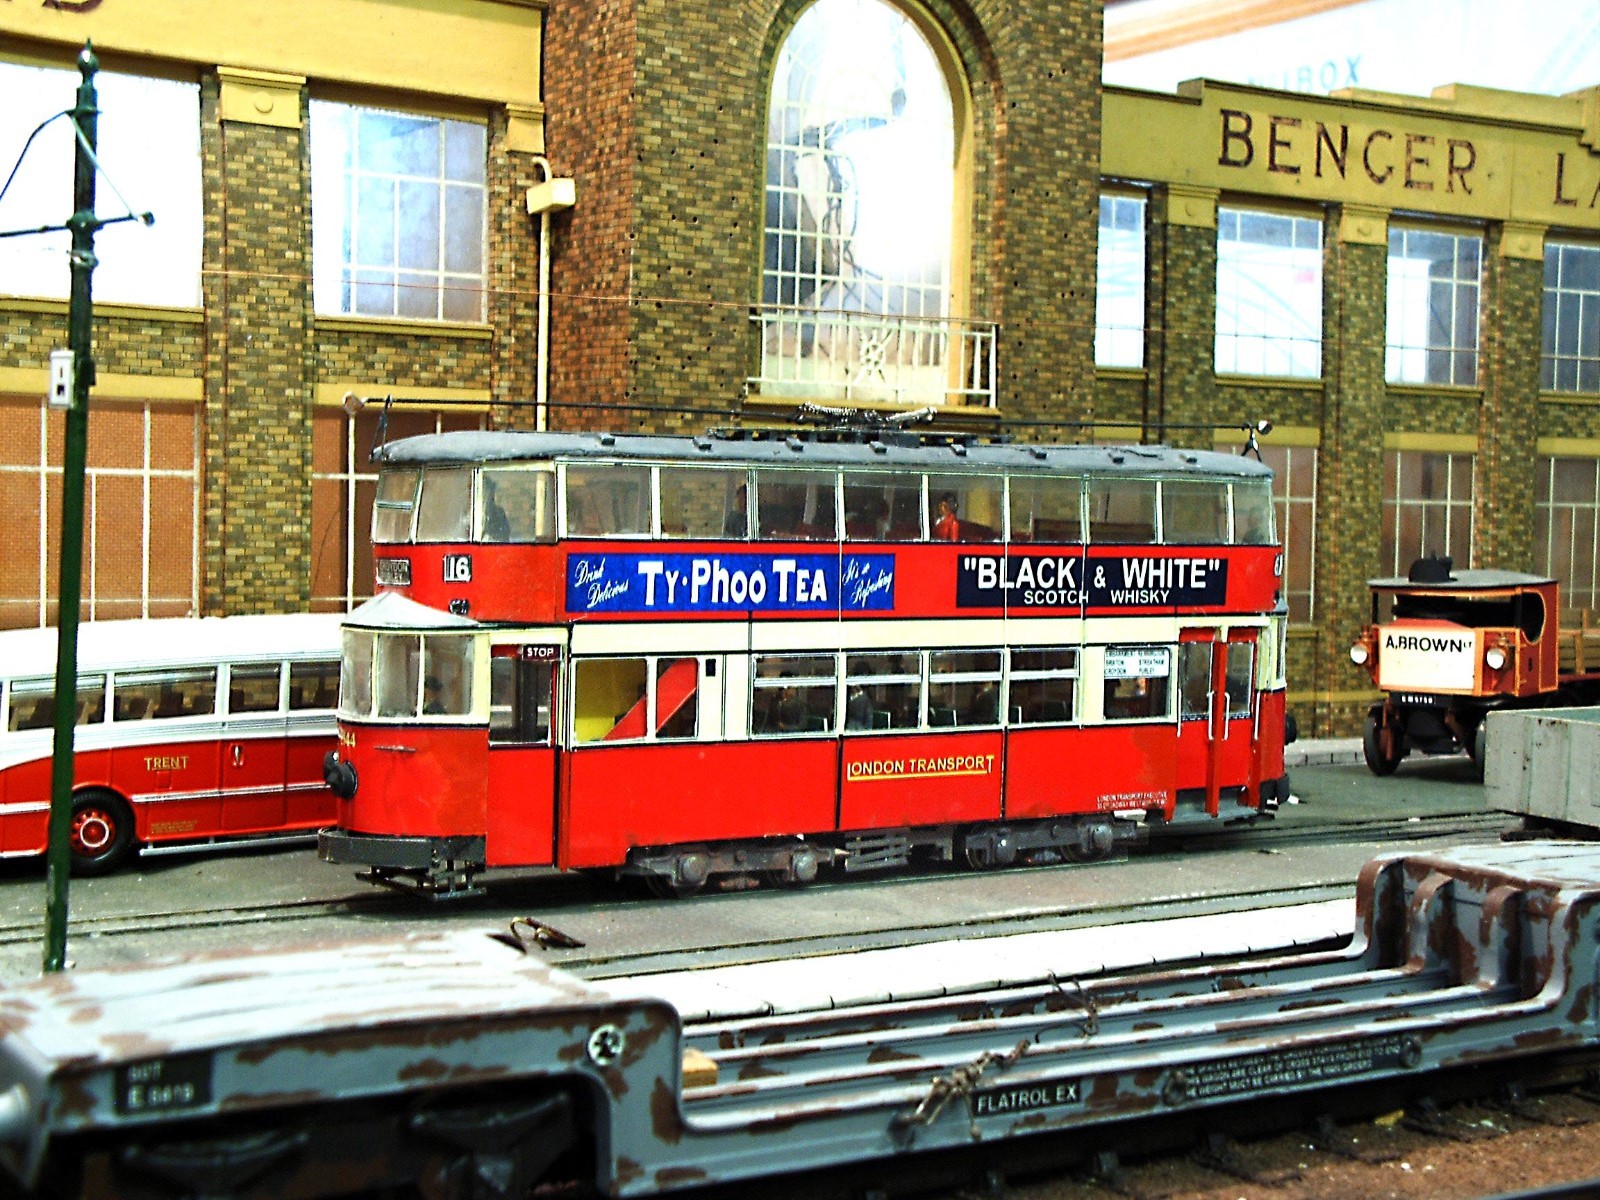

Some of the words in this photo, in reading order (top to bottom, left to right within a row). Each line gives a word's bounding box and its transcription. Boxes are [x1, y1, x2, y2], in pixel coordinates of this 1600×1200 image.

[1218, 108, 1477, 195] BENGER
[1553, 152, 1600, 208] L
[448, 556, 470, 580] 16
[575, 557, 606, 588] Drink
[772, 559, 827, 602] TEA
[1094, 566, 1107, 589] &
[1024, 590, 1089, 605] SCOTCH
[1110, 589, 1170, 604] WHISKY
[527, 647, 554, 658] STOP
[144, 755, 189, 771] TRENT
[847, 759, 904, 780] LONDON
[910, 754, 994, 774] TRANSPORT
[978, 1088, 1050, 1112] FLATROL
[1056, 1084, 1076, 1101] EX
